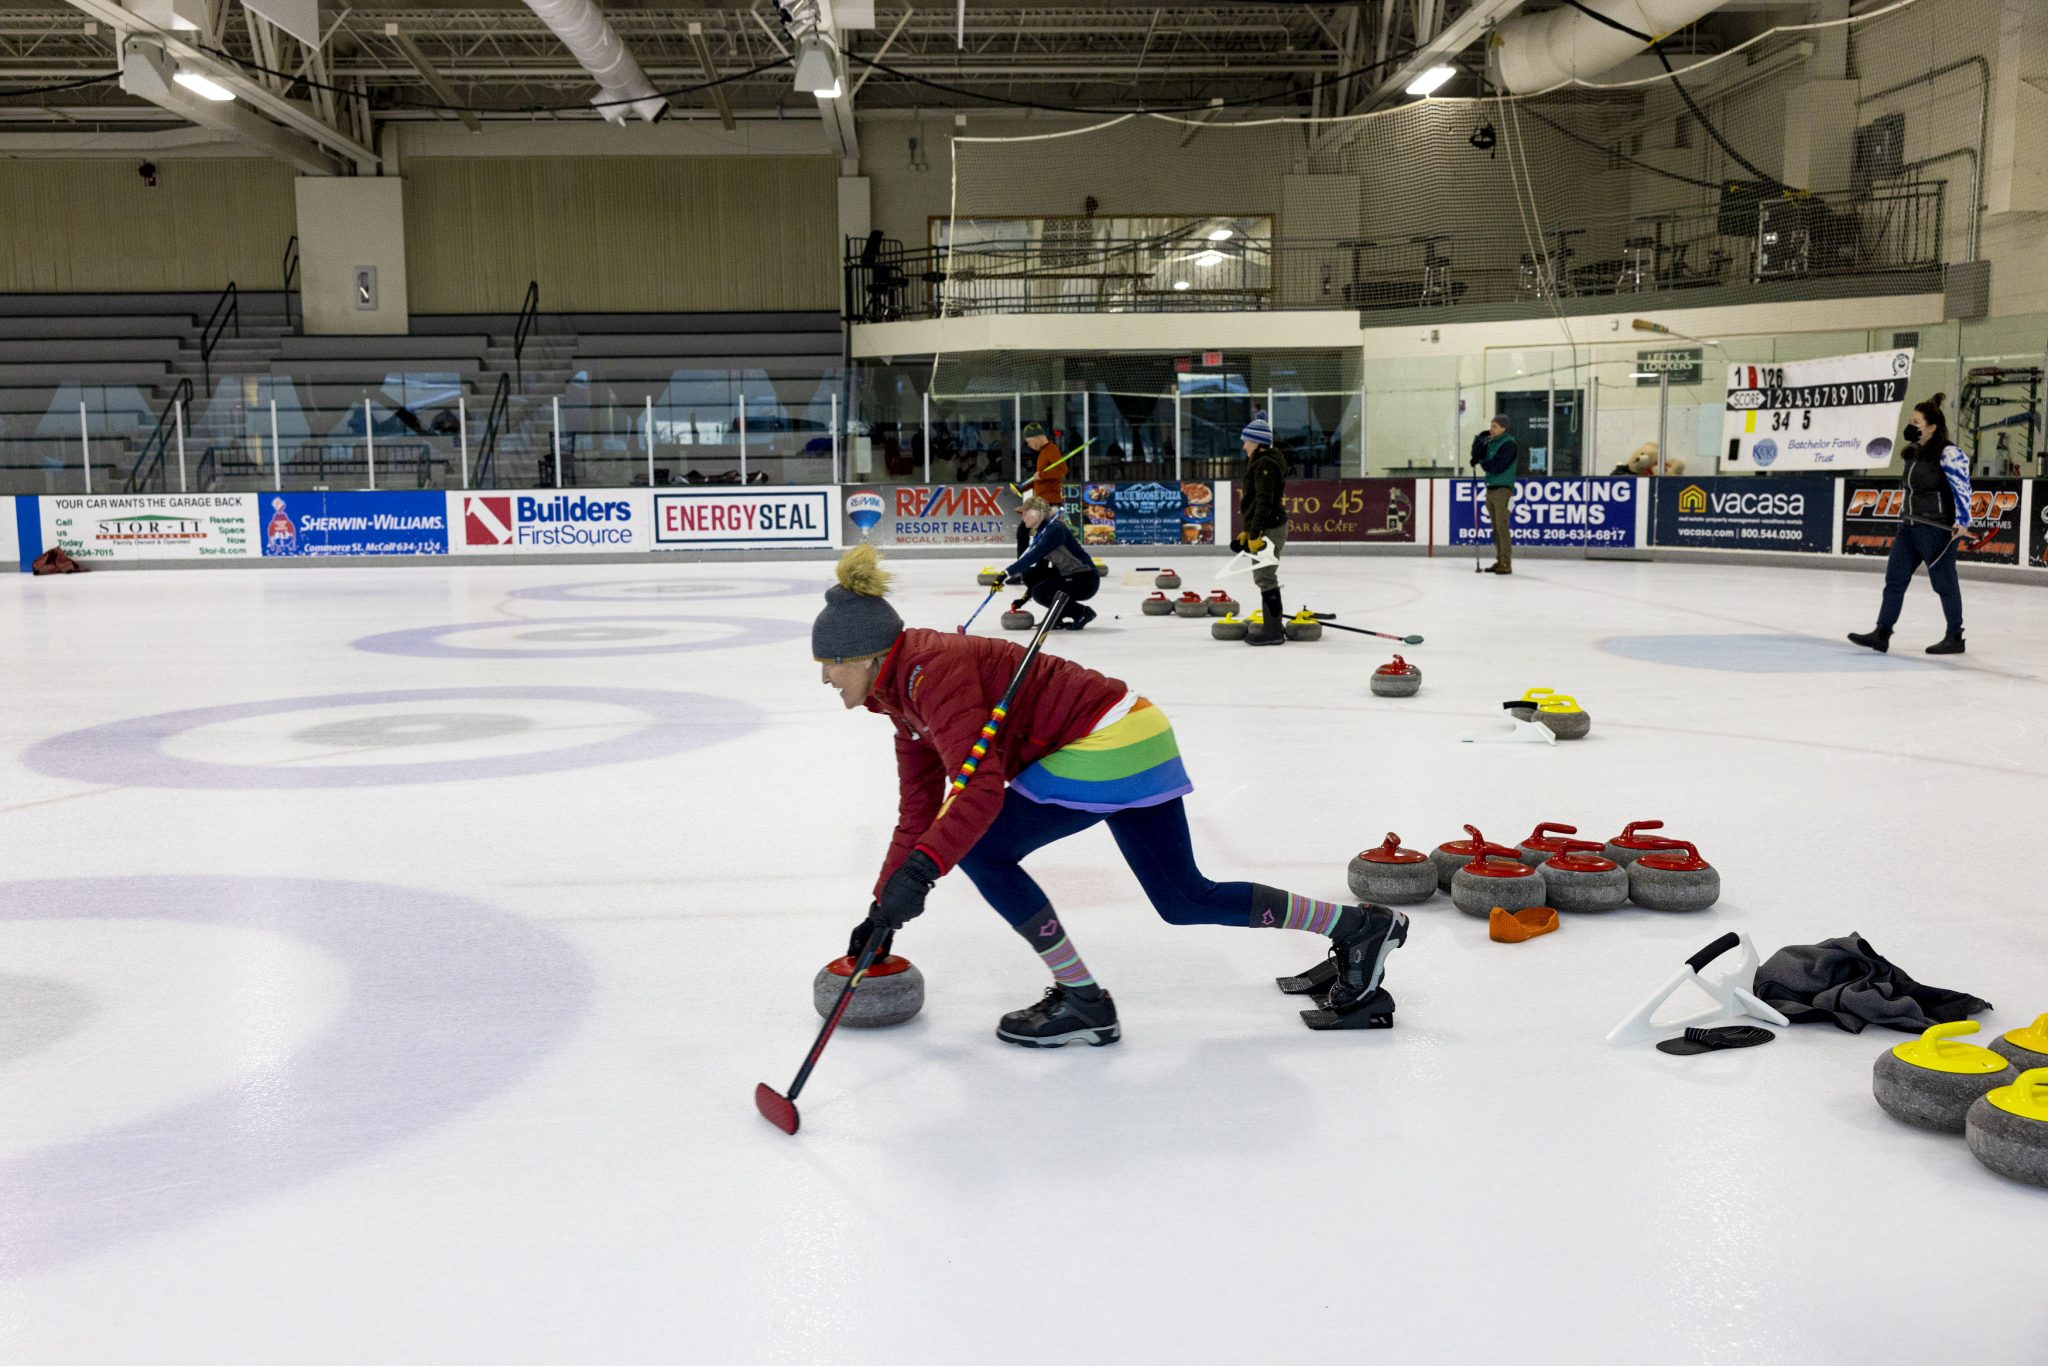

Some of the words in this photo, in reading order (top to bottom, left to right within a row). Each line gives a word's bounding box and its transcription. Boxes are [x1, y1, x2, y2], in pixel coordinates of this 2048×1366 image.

[1733, 391, 1760, 407] SCORE
[1766, 391, 1772, 408] 1
[1775, 391, 1783, 408] 2
[1785, 391, 1793, 408] 3
[1795, 390, 1803, 407] 4
[1804, 390, 1812, 407] 5
[1813, 389, 1821, 406] 6
[1822, 388, 1830, 406] 7
[1831, 387, 1838, 405] 8
[1840, 387, 1848, 405] 9
[1852, 385, 1865, 404] 10
[1868, 384, 1879, 403] 11
[1884, 382, 1896, 402] 12
[1787, 438, 1831, 450] Batchelor
[1832, 437, 1861, 450] Family
[1813, 453, 1835, 463] Trust
[896, 485, 1005, 518] RE/MAX
[1115, 490, 1134, 501] BLUE
[1135, 490, 1160, 501] MOOSE
[1160, 490, 1182, 501] PIZZA
[56, 500, 84, 510] YOUR
[87, 499, 110, 510] CAR
[110, 499, 145, 509] WANTS
[148, 499, 167, 508] THE
[169, 498, 211, 508] GARAGE
[215, 497, 243, 507] BACK
[1332, 489, 1365, 515] 45
[1711, 492, 1805, 516] vacasa
[517, 496, 631, 522] Builders
[56, 519, 73, 527] Call
[209, 516, 245, 525] Reserve
[1987, 520, 2012, 529] HOMES
[218, 526, 245, 537] Space
[896, 521, 947, 534] RESORT
[953, 521, 1003, 533] REALTY
[1312, 523, 1322, 533] &
[519, 525, 633, 544] FirstSource
[1459, 528, 1494, 540] BOAT
[1544, 529, 1626, 541] 208-634-6817
[1678, 528, 1734, 538] vacasa.com
[1741, 528, 1803, 540] 800.544.0300
[58, 539, 84, 550] Today
[226, 537, 246, 545] Now
[304, 543, 351, 553] Commerce
